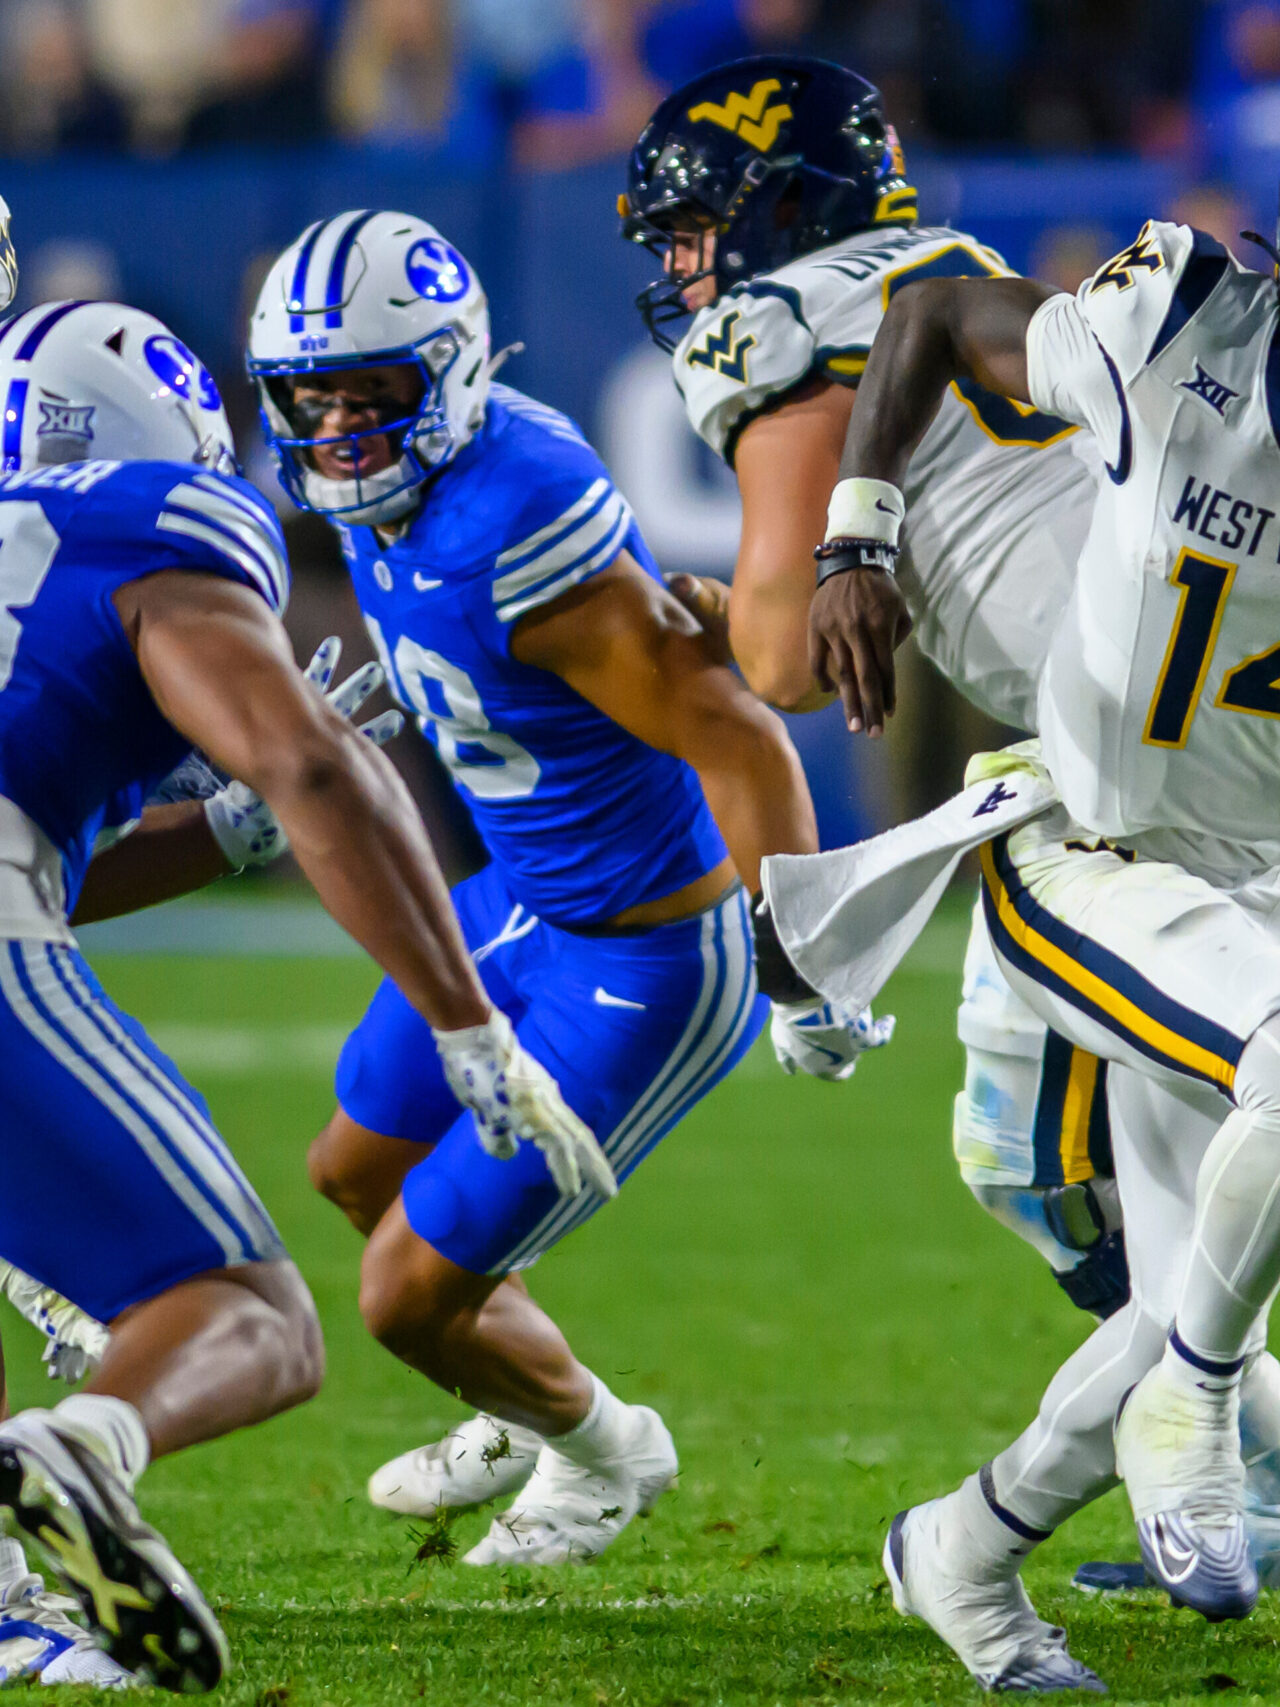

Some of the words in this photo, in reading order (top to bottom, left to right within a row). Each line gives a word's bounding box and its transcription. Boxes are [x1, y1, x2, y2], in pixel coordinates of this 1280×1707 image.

[410, 239, 464, 293] Y
[300, 335, 329, 351] BYU
[1179, 362, 1240, 417] XII
[1172, 475, 1276, 556] WEST
